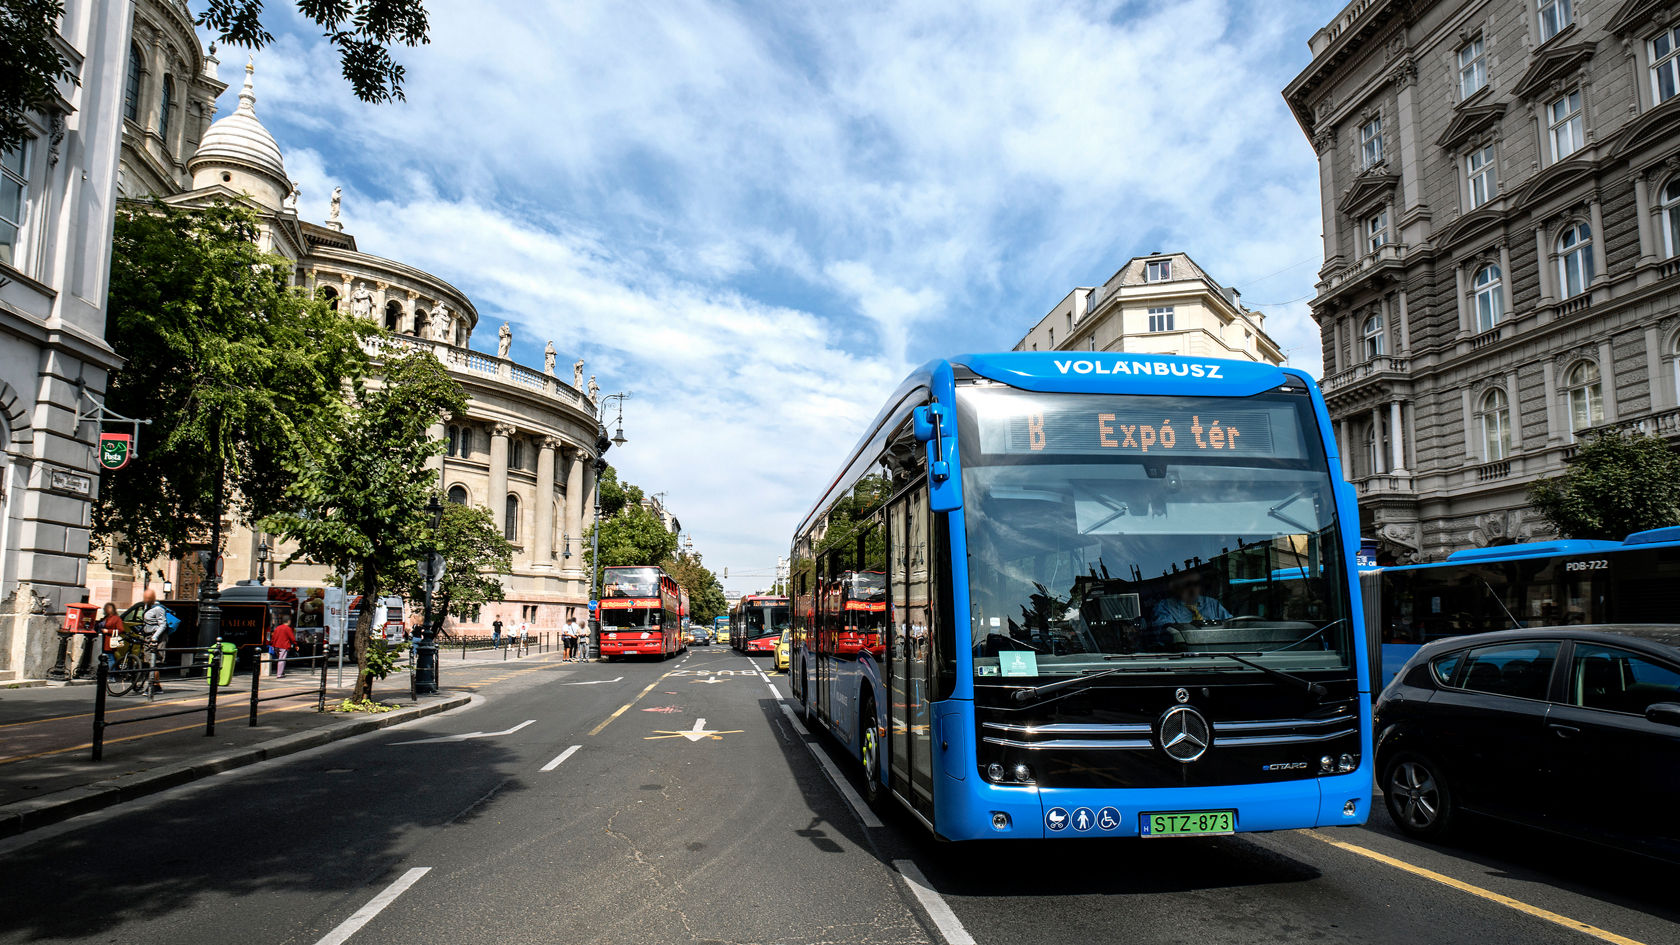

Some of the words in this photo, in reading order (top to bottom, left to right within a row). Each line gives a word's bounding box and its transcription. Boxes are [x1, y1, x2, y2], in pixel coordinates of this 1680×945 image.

[1053, 360, 1224, 379] VOLÁNBUSZ
[1028, 411, 1046, 451] B
[1098, 412, 1177, 453] Expó
[1190, 415, 1241, 450] tér
[104, 452, 121, 461] Posta
[1566, 559, 1609, 571] PDB-722
[1154, 813, 1229, 832] STZ-873
